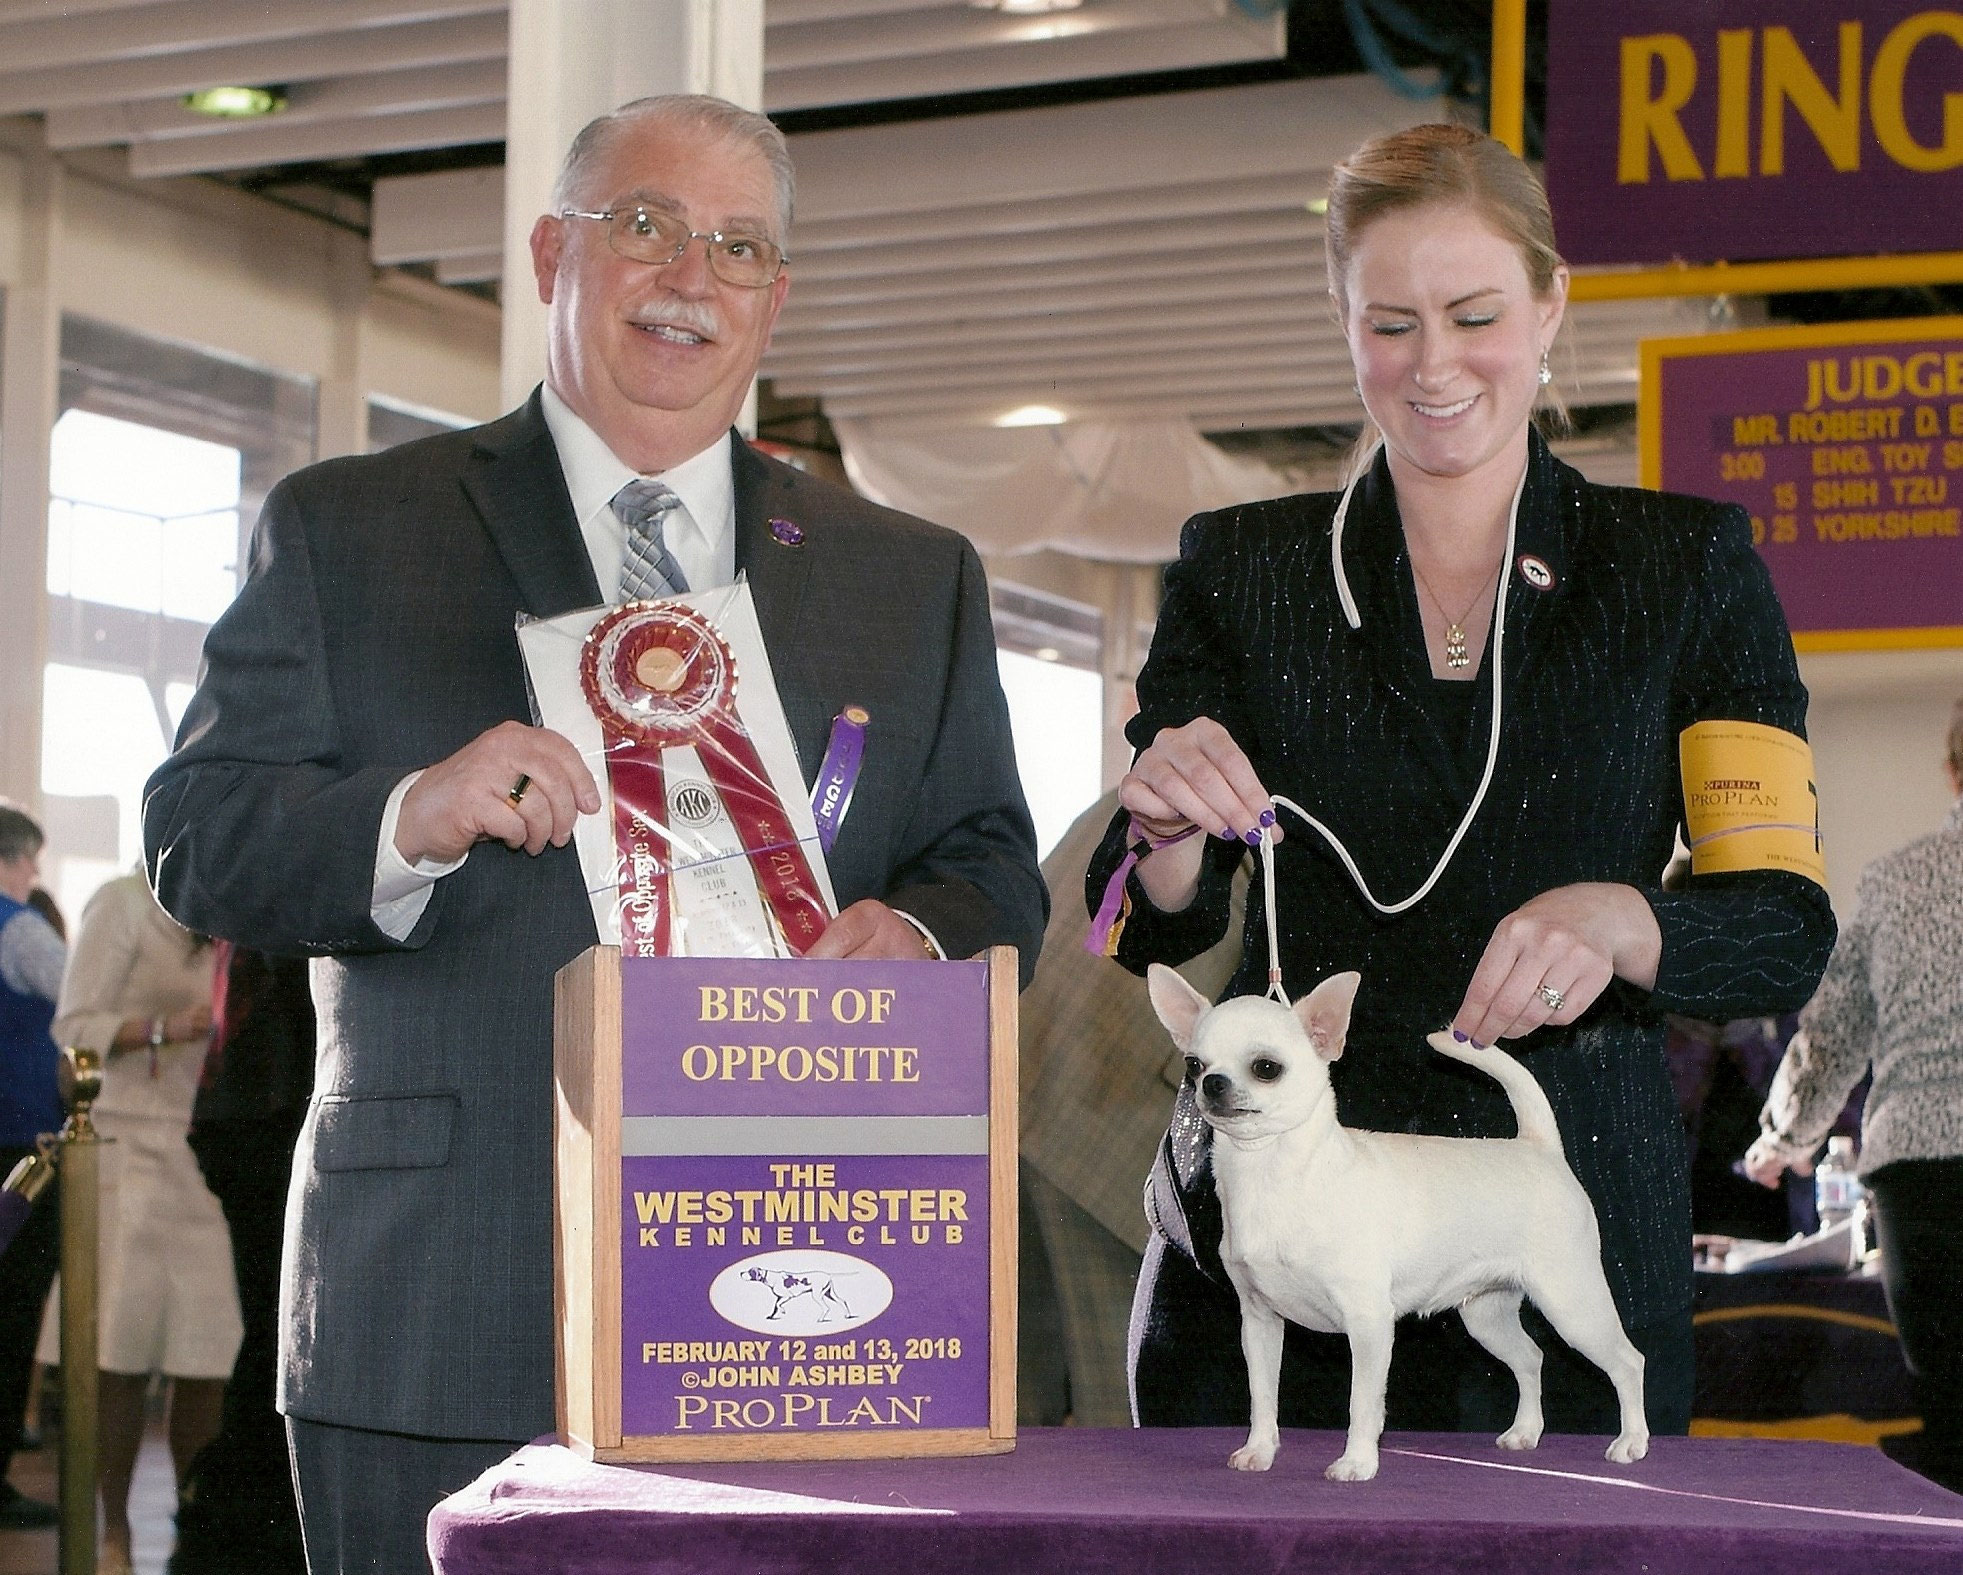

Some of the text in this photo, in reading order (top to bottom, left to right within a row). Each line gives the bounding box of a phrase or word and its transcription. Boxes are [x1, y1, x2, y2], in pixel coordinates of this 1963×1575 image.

[1617, 11, 1963, 184] RING
[1789, 408, 1903, 443] ROBERT
[1881, 444, 1931, 471] TOY
[1812, 481, 1879, 509] SHIH
[1891, 476, 1948, 506] TZU
[1813, 509, 1961, 541] YORKSHIRE
[1714, 780, 1760, 791] PURINA
[698, 986, 896, 1024] BEST OF
[681, 1045, 921, 1083] OPPOSITE
[769, 1164, 836, 1188] THE
[633, 1189, 969, 1224] WESTMINSTER
[639, 1226, 965, 1247] KENNEL CLUB
[642, 1337, 962, 1364] FEBRUARY 12 and 13, 2018
[787, 1363, 904, 1387] ASHBEY
